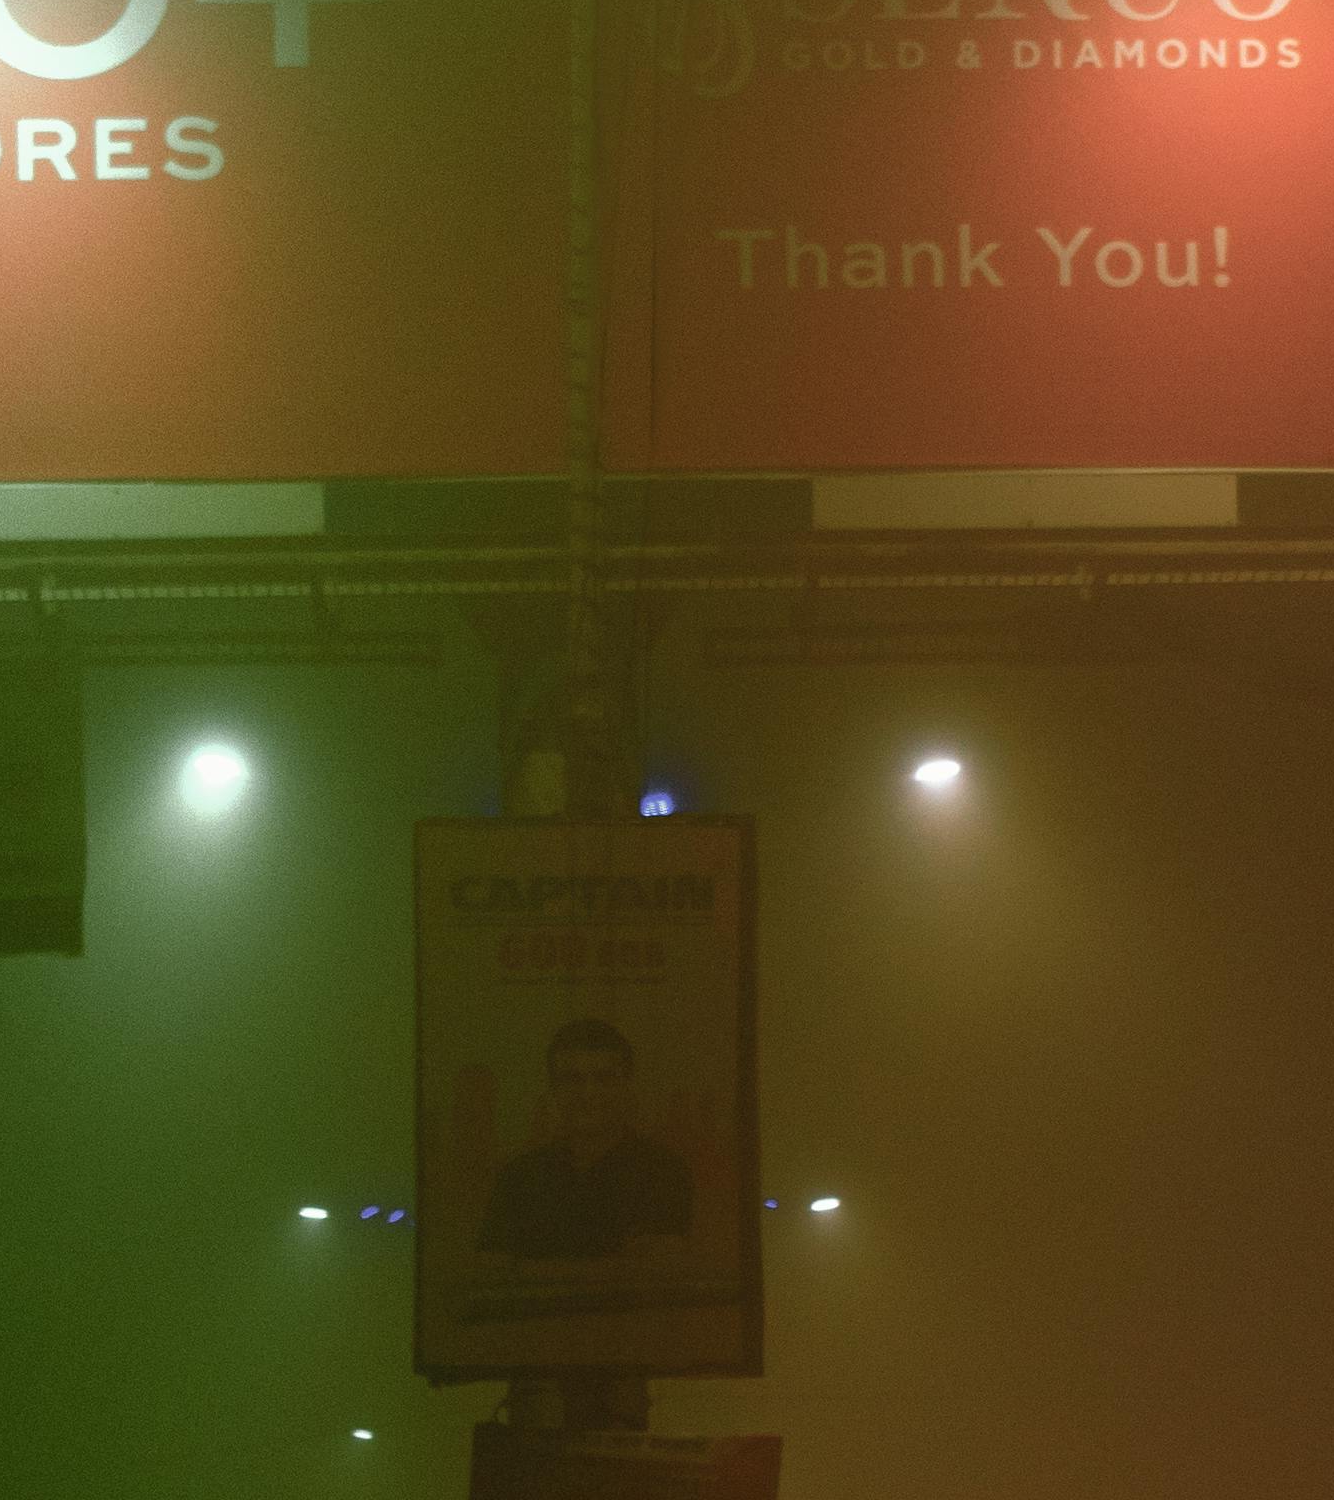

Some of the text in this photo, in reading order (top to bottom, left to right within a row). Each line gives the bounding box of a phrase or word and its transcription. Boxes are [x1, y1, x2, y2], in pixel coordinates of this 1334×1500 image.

[782, 36, 1303, 71] GOLD & DIAMONDS
[714, 223, 1234, 289] Thank You!
[448, 875, 714, 911] CAPTAIN
